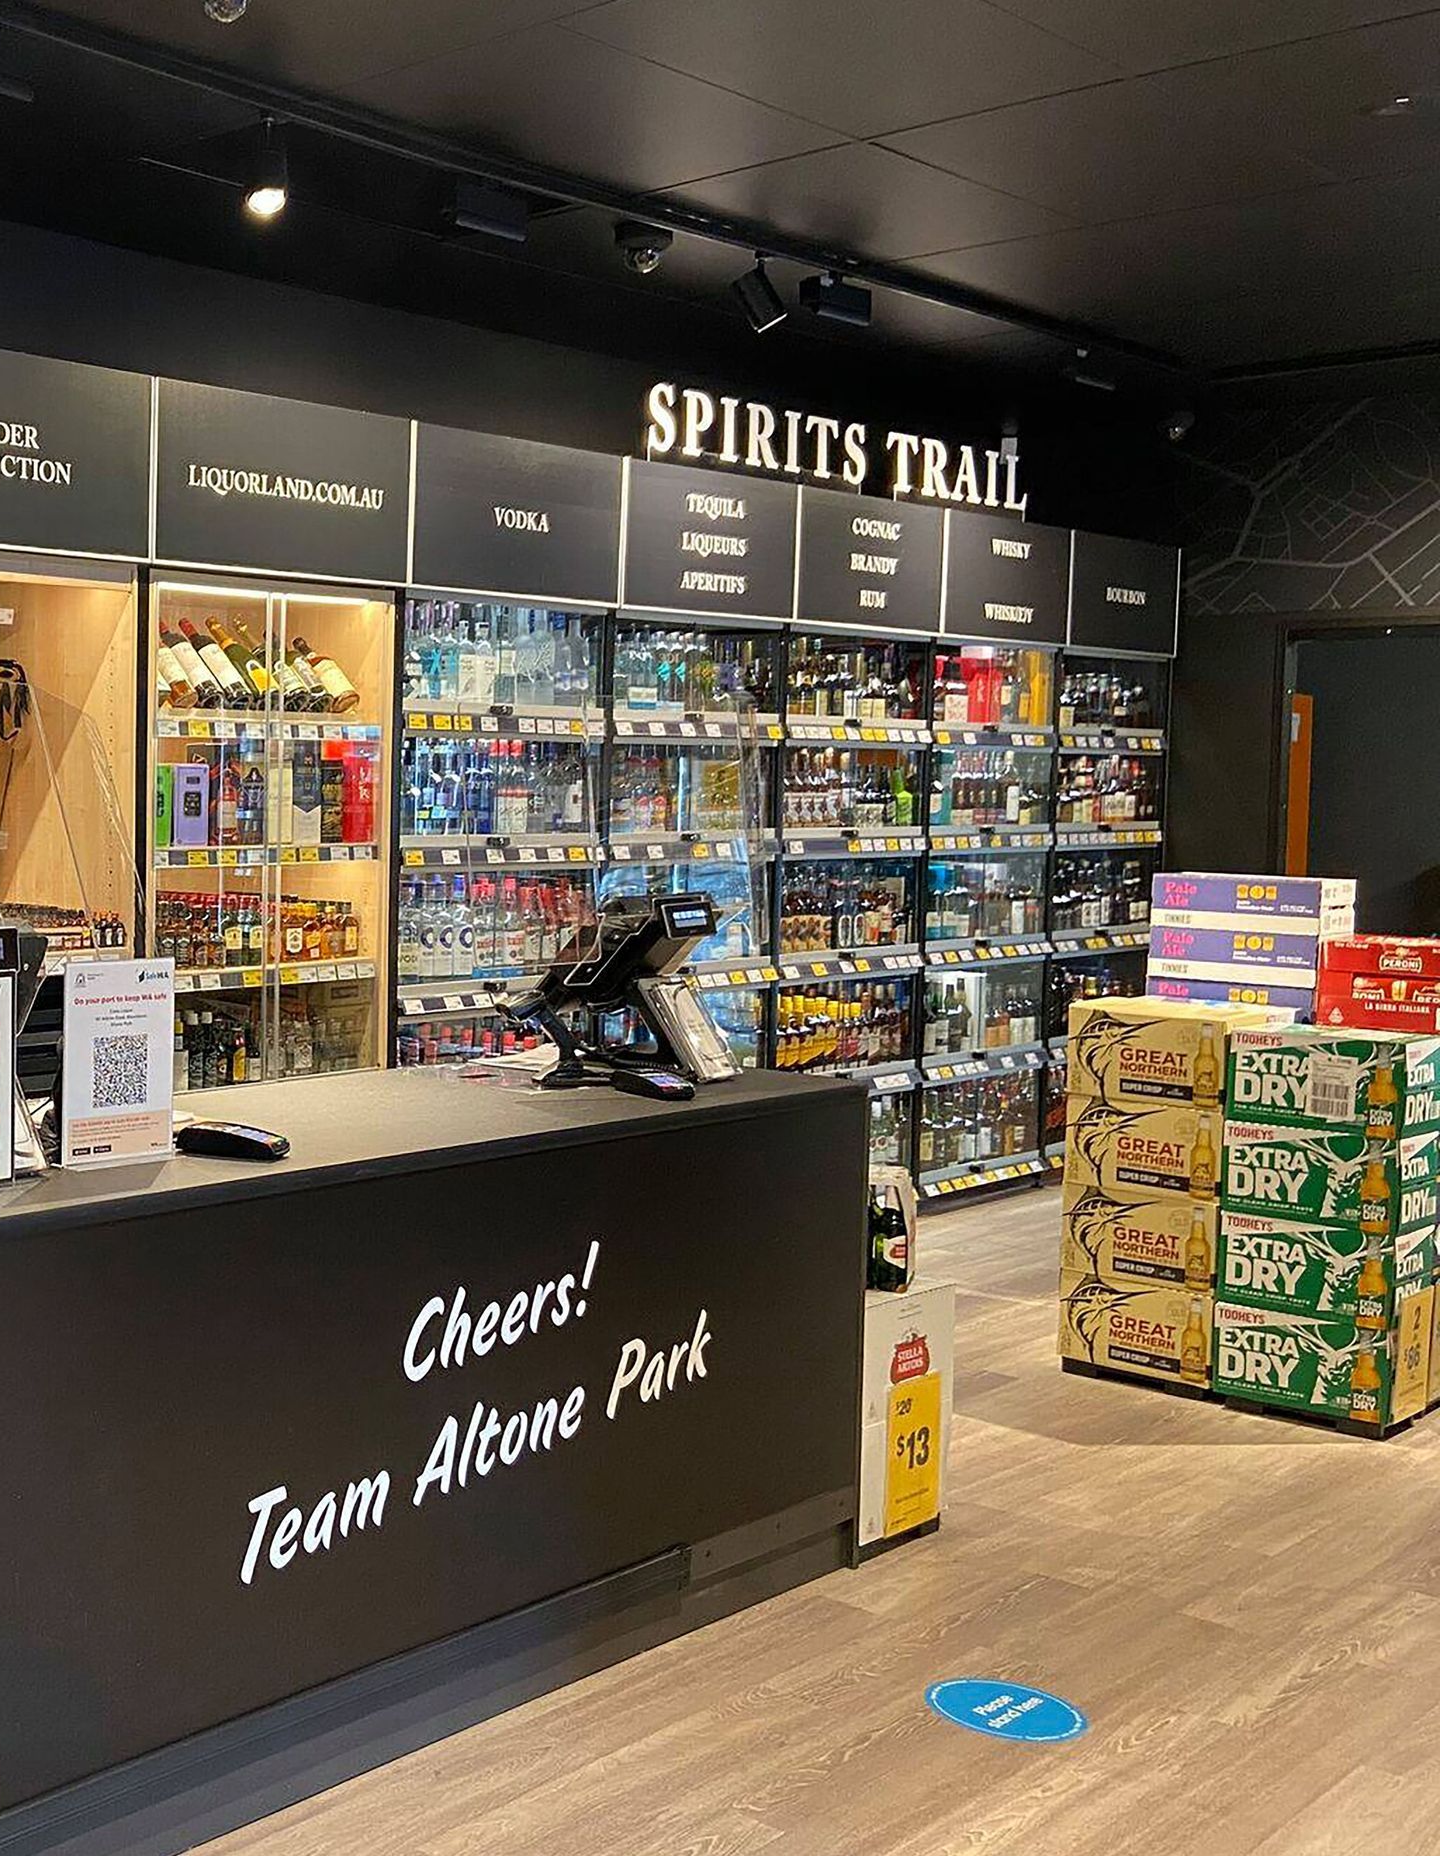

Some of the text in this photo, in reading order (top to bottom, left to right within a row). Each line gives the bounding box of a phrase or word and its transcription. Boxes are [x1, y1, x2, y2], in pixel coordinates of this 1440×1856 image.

[648, 382, 1027, 509] SPIRITS TRAIL
[189, 464, 384, 510] LIQUORLAND.COM.AU
[686, 493, 745, 521] TEQUILA
[494, 507, 549, 533] VODKA
[852, 517, 901, 541] COGNAC
[681, 532, 748, 557] LIQUEURS
[992, 538, 1031, 560] WHISKY
[851, 553, 898, 576] BRANDY
[680, 571, 747, 594] APERITIFS
[860, 590, 885, 609] RUM
[1107, 587, 1146, 605] BOURBON
[1164, 895, 1189, 908] Ale
[1161, 944, 1186, 956] Ale
[1383, 959, 1419, 968] PERONI
[1237, 1032, 1283, 1047] TOOHEYS
[1120, 1048, 1188, 1067] GREAT
[1237, 1052, 1310, 1077] EXTRA
[1120, 1062, 1188, 1078] NORTHERN
[1408, 1063, 1435, 1086] EXTRA
[1235, 1073, 1312, 1108] DRY
[1405, 1091, 1432, 1125] DRY
[1228, 1126, 1274, 1140] TOOHEYS
[1118, 1137, 1184, 1157] GREAT
[1117, 1151, 1184, 1169] NORTHERN
[1230, 1146, 1309, 1173] EXTRA
[1402, 1157, 1430, 1180] EXTRA
[1228, 1166, 1308, 1203] DRY
[1402, 1188, 1429, 1224] DRY
[1228, 1215, 1273, 1232] TOOHEYS
[1114, 1227, 1179, 1249] GREAT
[1113, 1242, 1179, 1260] NORTHERN
[1228, 1235, 1307, 1265] EXTRA
[1225, 1255, 1307, 1296] DRY
[1396, 1252, 1424, 1278] EXTRA
[403, 1240, 600, 1382] Cheers!
[1219, 1308, 1265, 1324] TOOHEYS
[1111, 1315, 1176, 1339] GREAT
[1109, 1328, 1175, 1351] NORTHERN
[1220, 1328, 1299, 1358] EXTRA
[898, 1346, 922, 1359] STELLA
[1218, 1348, 1299, 1389] DRY
[240, 1309, 712, 1584] Team Altone Park
[896, 1426, 929, 1469] $13
